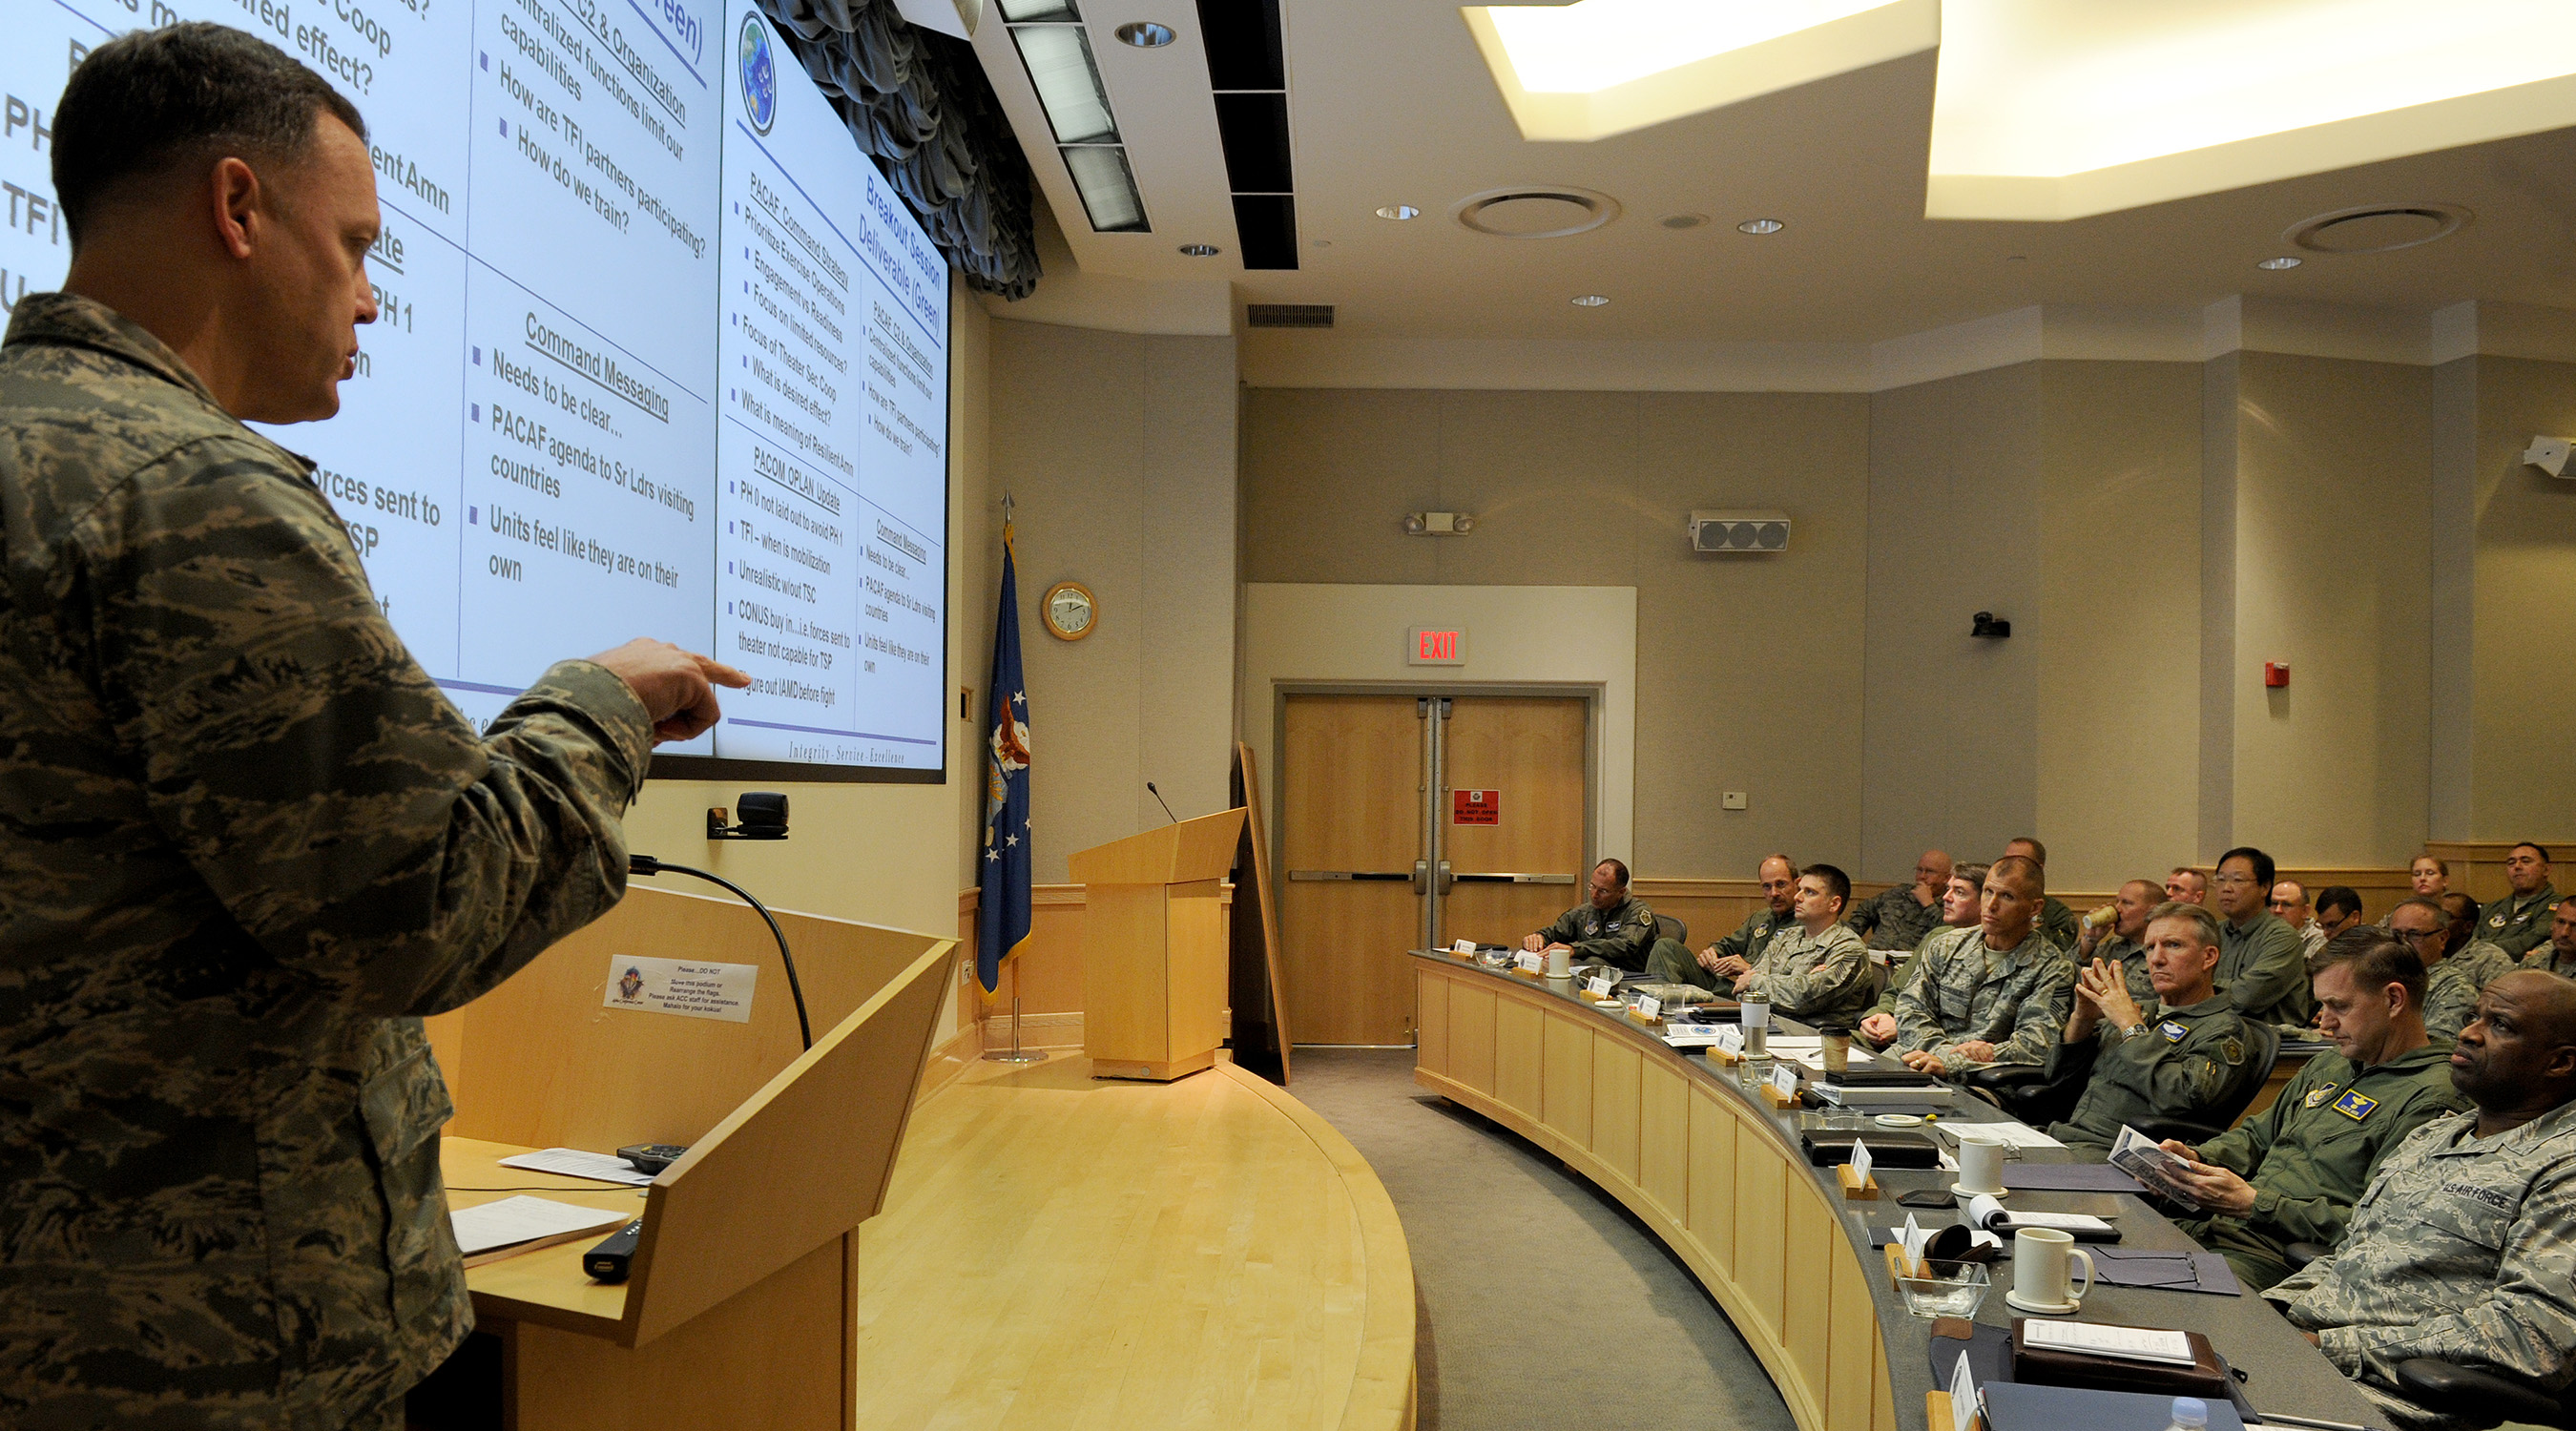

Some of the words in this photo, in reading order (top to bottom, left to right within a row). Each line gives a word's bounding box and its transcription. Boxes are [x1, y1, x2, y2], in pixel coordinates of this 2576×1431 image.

[297, 24, 373, 96] effect?
[501, 13, 582, 101] capabilities
[599, 13, 610, 42] &
[613, 28, 686, 122] Organization
[585, 48, 640, 119] functions
[641, 103, 666, 144] limit
[667, 134, 684, 161] our
[500, 59, 534, 111] How
[536, 99, 558, 132] are
[562, 114, 583, 155] TFI
[586, 141, 635, 197] partners
[637, 186, 707, 259] participating?
[518, 124, 551, 172] How
[552, 156, 571, 189] do
[572, 176, 592, 205] we
[594, 188, 631, 235] train?
[2, 179, 59, 245] TFI
[750, 171, 779, 215] PACAF
[782, 205, 821, 259] Command
[821, 245, 849, 289] Strategy
[866, 174, 908, 250] Breakout
[909, 230, 941, 291] Session
[745, 205, 780, 255] Prioritize
[780, 239, 811, 282] Exercise
[811, 270, 845, 316] Operations
[859, 213, 911, 296] Deliverable
[911, 277, 940, 338] (Green)
[404, 302, 413, 334] 1
[754, 249, 802, 307] Engagement
[801, 297, 810, 314] vs
[811, 300, 843, 343] Readiness
[742, 314, 768, 350] Focus
[769, 339, 779, 357] of
[779, 342, 805, 378] Theater
[806, 363, 819, 388] Sec
[820, 375, 837, 405] Coop
[754, 282, 778, 320] Focus
[779, 309, 789, 328] on
[790, 313, 814, 348] limited
[814, 338, 848, 377] resources?
[492, 348, 540, 397] Needs
[543, 376, 558, 405] to
[561, 384, 578, 414] be
[525, 311, 601, 378] Command
[604, 357, 669, 416] Messaging
[752, 355, 773, 387] What
[774, 370, 781, 392] is
[782, 379, 809, 411] desired
[809, 399, 832, 427] effect?
[741, 388, 763, 420] What
[764, 404, 771, 425] is
[773, 413, 804, 449] meaning
[804, 433, 812, 450] of
[490, 454, 561, 499] countries
[491, 404, 548, 451] PACAF
[549, 436, 597, 474] agenda
[599, 454, 613, 481] to
[614, 461, 628, 487] Sr
[630, 467, 655, 500] Ldrs
[657, 483, 695, 522] visiting
[754, 446, 785, 482] PACOM
[788, 466, 815, 497] OPLAN
[817, 482, 841, 511] Update
[374, 486, 417, 521] sent
[422, 495, 441, 527] to
[740, 480, 753, 505] PH
[761, 494, 775, 514] not
[776, 497, 790, 521] laid
[790, 508, 802, 528] out
[802, 511, 810, 531] to
[810, 519, 829, 540] avoid
[488, 554, 522, 582] own
[489, 504, 530, 542] Units
[533, 519, 560, 551] feel
[562, 528, 586, 560] like
[588, 537, 614, 574] they
[617, 552, 635, 576] are
[637, 559, 653, 579] on
[654, 561, 679, 590] their
[740, 519, 754, 544] TFI
[761, 531, 782, 555] when
[782, 538, 790, 558] is
[791, 547, 831, 575] mobilization
[739, 559, 781, 592] Unrealistic
[802, 583, 817, 604] TSC
[865, 575, 884, 597] PACAF
[738, 599, 769, 626] CONUS
[770, 608, 784, 634] buy
[810, 621, 829, 643] forces
[830, 631, 844, 647] sent
[844, 632, 851, 649] to
[738, 631, 767, 655] theater
[768, 641, 780, 659] not
[782, 646, 808, 666] capable
[809, 649, 819, 667] for
[820, 651, 833, 671] TSP
[1420, 631, 1459, 659] EXIT
[765, 677, 779, 696] out
[779, 678, 799, 698] IAMD
[799, 680, 820, 702] before
[821, 686, 836, 708] fight
[789, 740, 829, 763] Integrity
[836, 745, 864, 762] Service
[870, 747, 905, 765] Excellence
[2457, 1185, 2472, 1197] AIR
[2472, 1188, 2508, 1210] FORCE
